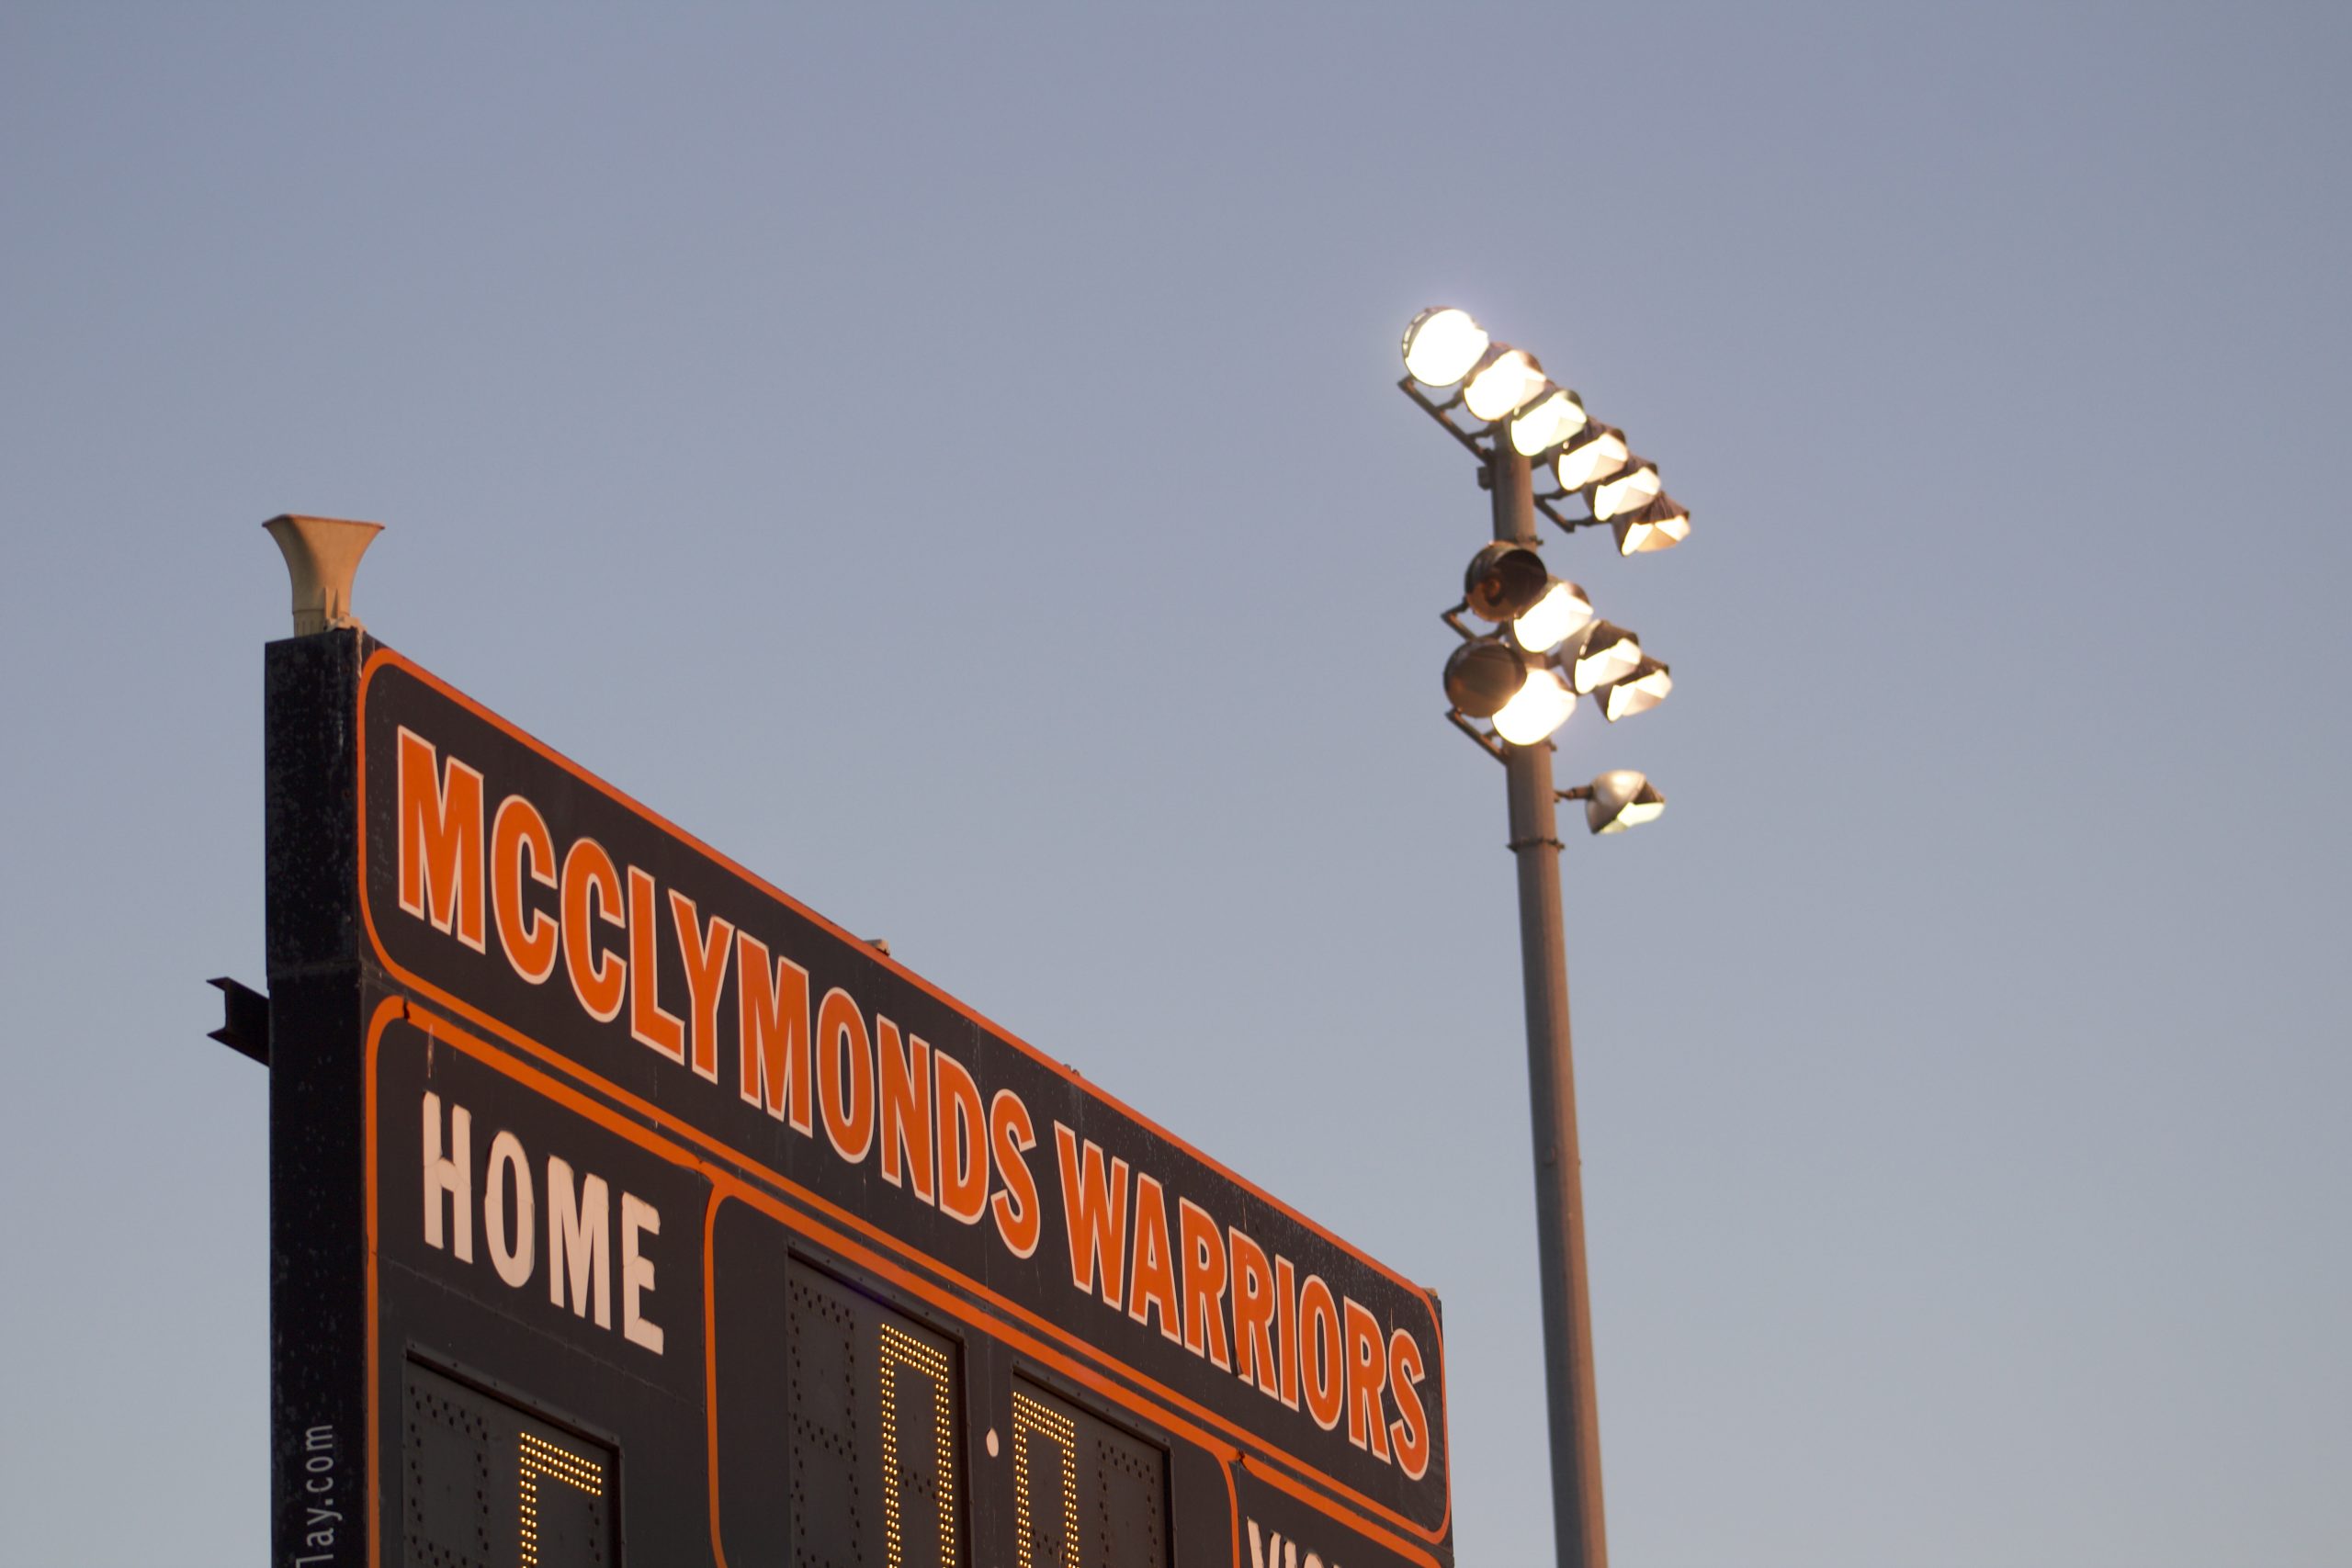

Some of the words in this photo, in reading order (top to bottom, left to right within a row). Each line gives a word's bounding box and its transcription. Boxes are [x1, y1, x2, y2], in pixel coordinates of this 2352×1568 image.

[397, 725, 1041, 1259] MCCLYMONDS
[1054, 1120, 1430, 1482] WARRIORS
[422, 1089, 664, 1356] HOME
